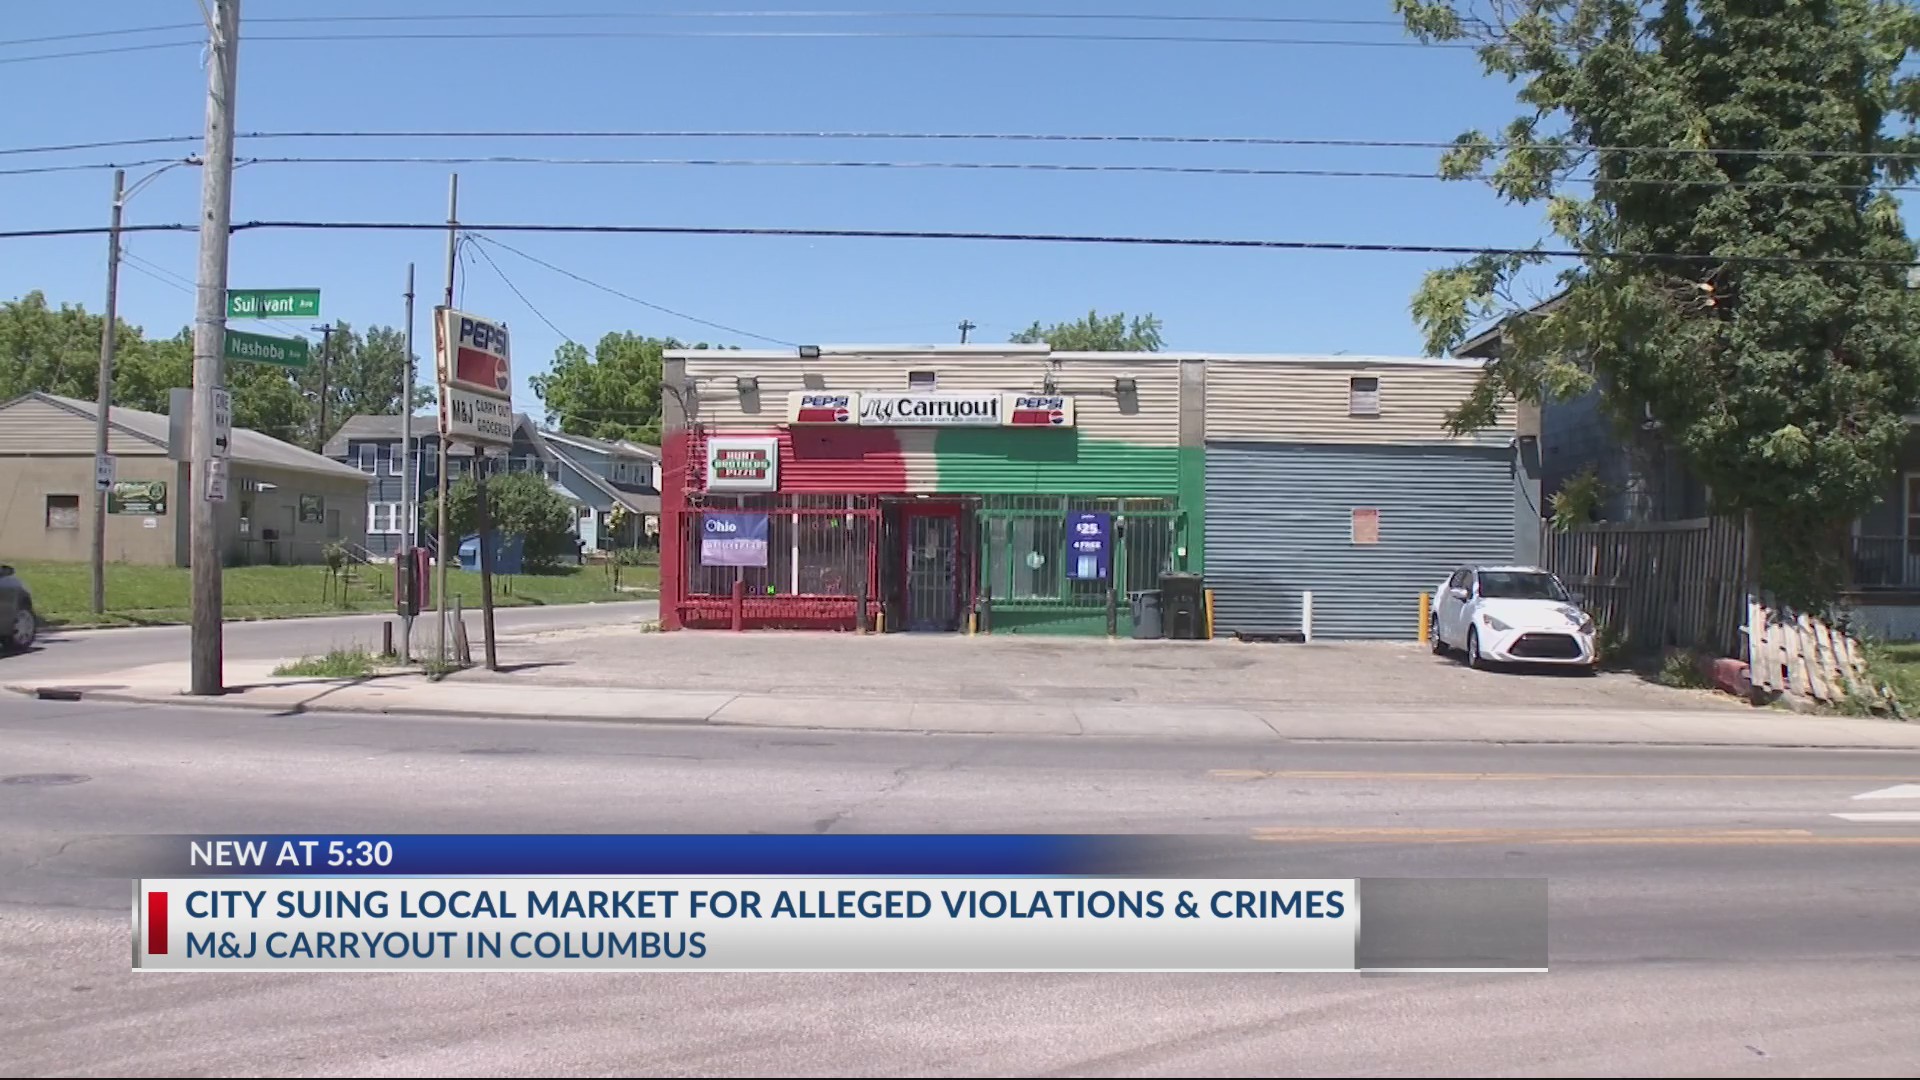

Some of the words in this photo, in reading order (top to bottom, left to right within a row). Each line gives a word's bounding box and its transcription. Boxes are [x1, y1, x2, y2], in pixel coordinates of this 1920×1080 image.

[233, 296, 294, 312] Sullivant
[460, 318, 506, 356] PEPSI
[232, 338, 285, 360] Nashoba
[475, 399, 497, 416] CARRY
[801, 395, 848, 407] PEPSI
[898, 398, 998, 418] Carryout
[1015, 397, 1063, 409] PEPSI
[452, 399, 474, 424] M&J
[726, 451, 756, 460] HUNT
[726, 469, 757, 477] PIZZA
[706, 519, 737, 532] Ohio
